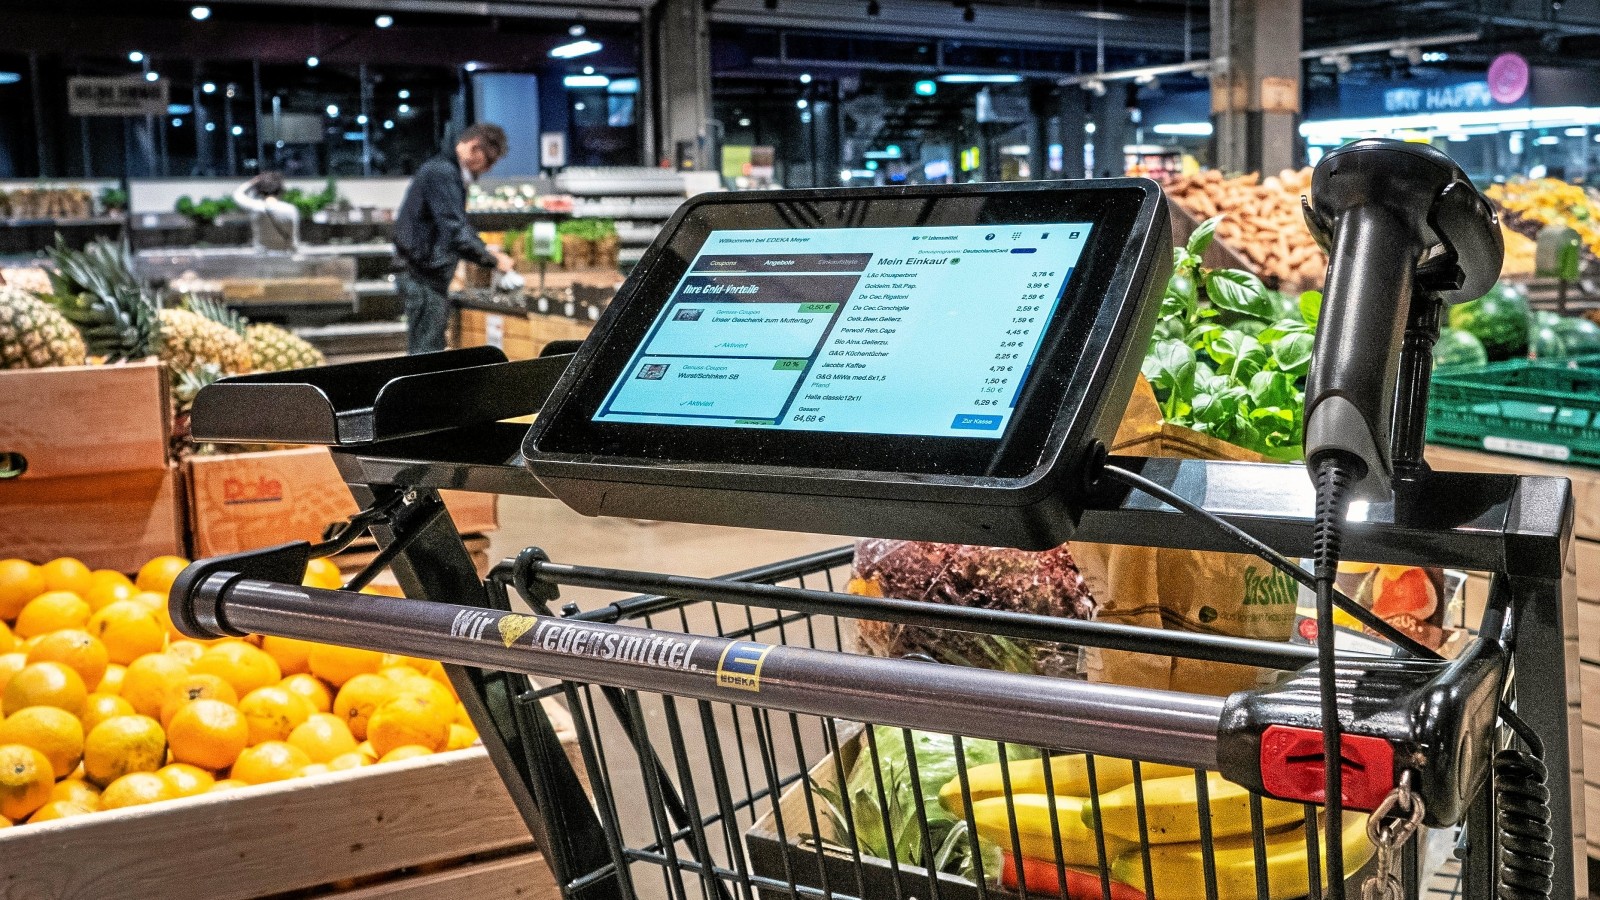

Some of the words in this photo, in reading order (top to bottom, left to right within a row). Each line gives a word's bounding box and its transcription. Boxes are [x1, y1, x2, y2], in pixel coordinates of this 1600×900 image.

[877, 257, 904, 265] Mein
[905, 257, 948, 265] Einkauf
[683, 285, 702, 295] Ihre
[702, 284, 760, 295] Gold-Vorteile
[793, 414, 816, 422] 64,68
[818, 415, 826, 423] €
[223, 476, 282, 500] Dole
[451, 609, 495, 641] Wir
[532, 619, 698, 671] Lebensmittel.
[720, 674, 756, 687] EDEKA
